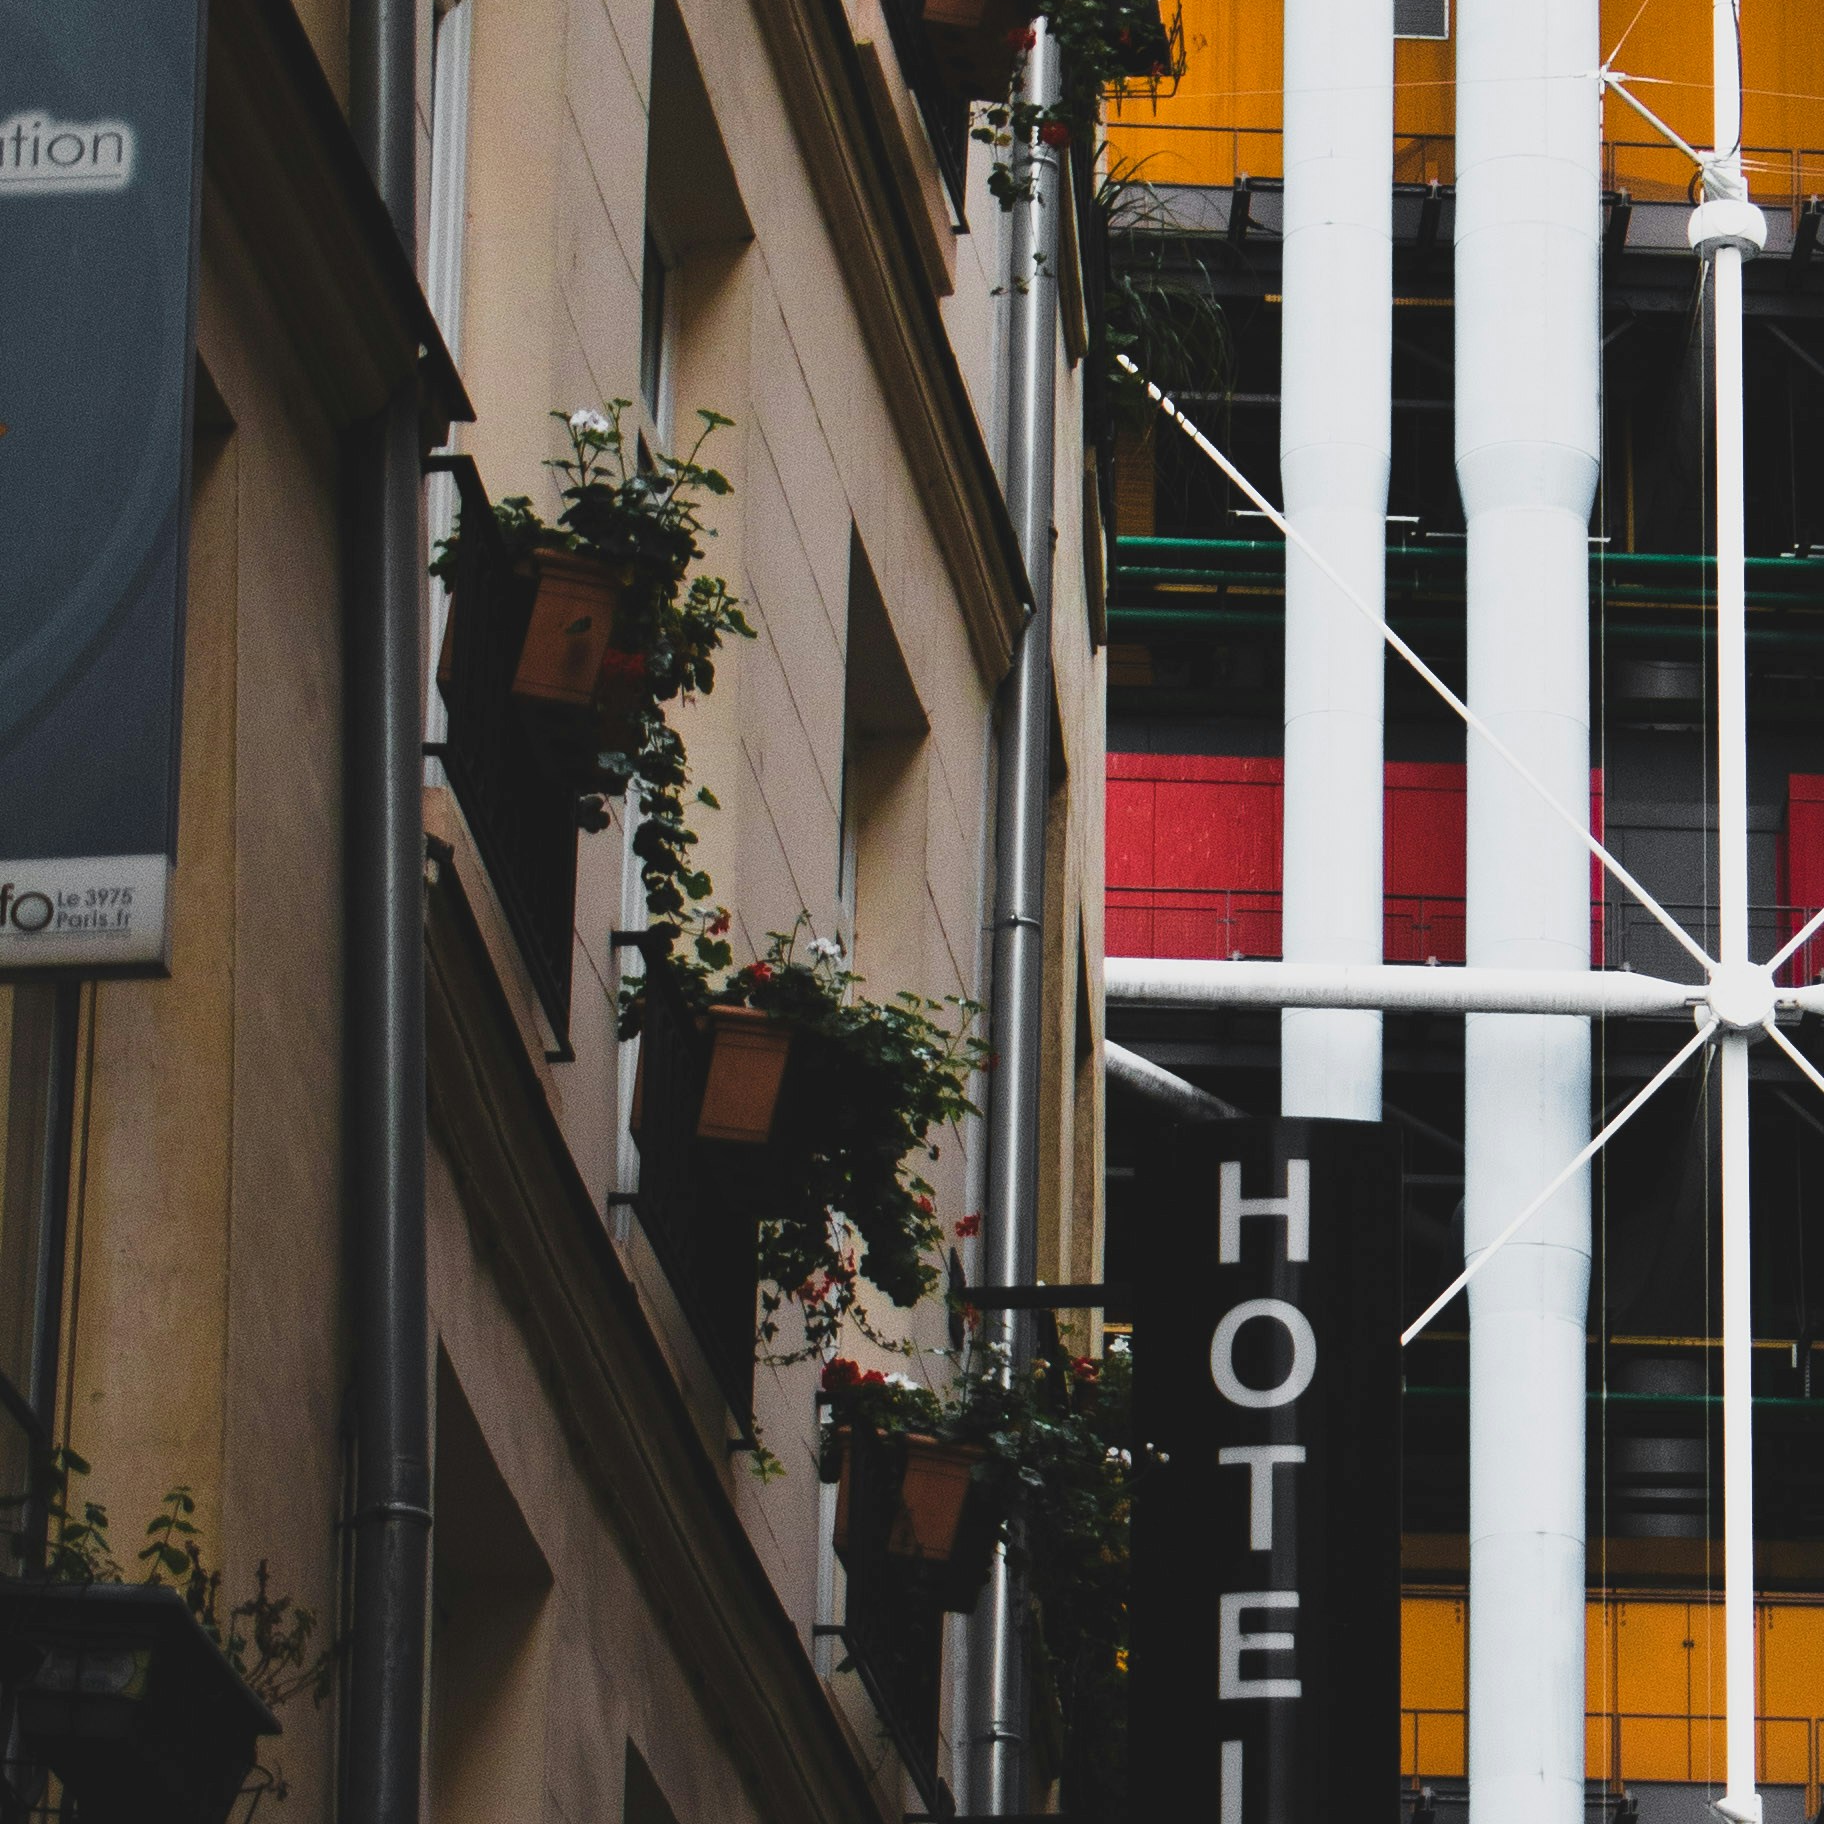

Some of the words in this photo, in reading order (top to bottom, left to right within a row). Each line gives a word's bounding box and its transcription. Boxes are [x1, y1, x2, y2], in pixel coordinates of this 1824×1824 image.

[0, 121, 123, 168] tion
[58, 889, 80, 908] Le
[85, 887, 134, 907] 3975
[57, 909, 130, 929] Paris.fr
